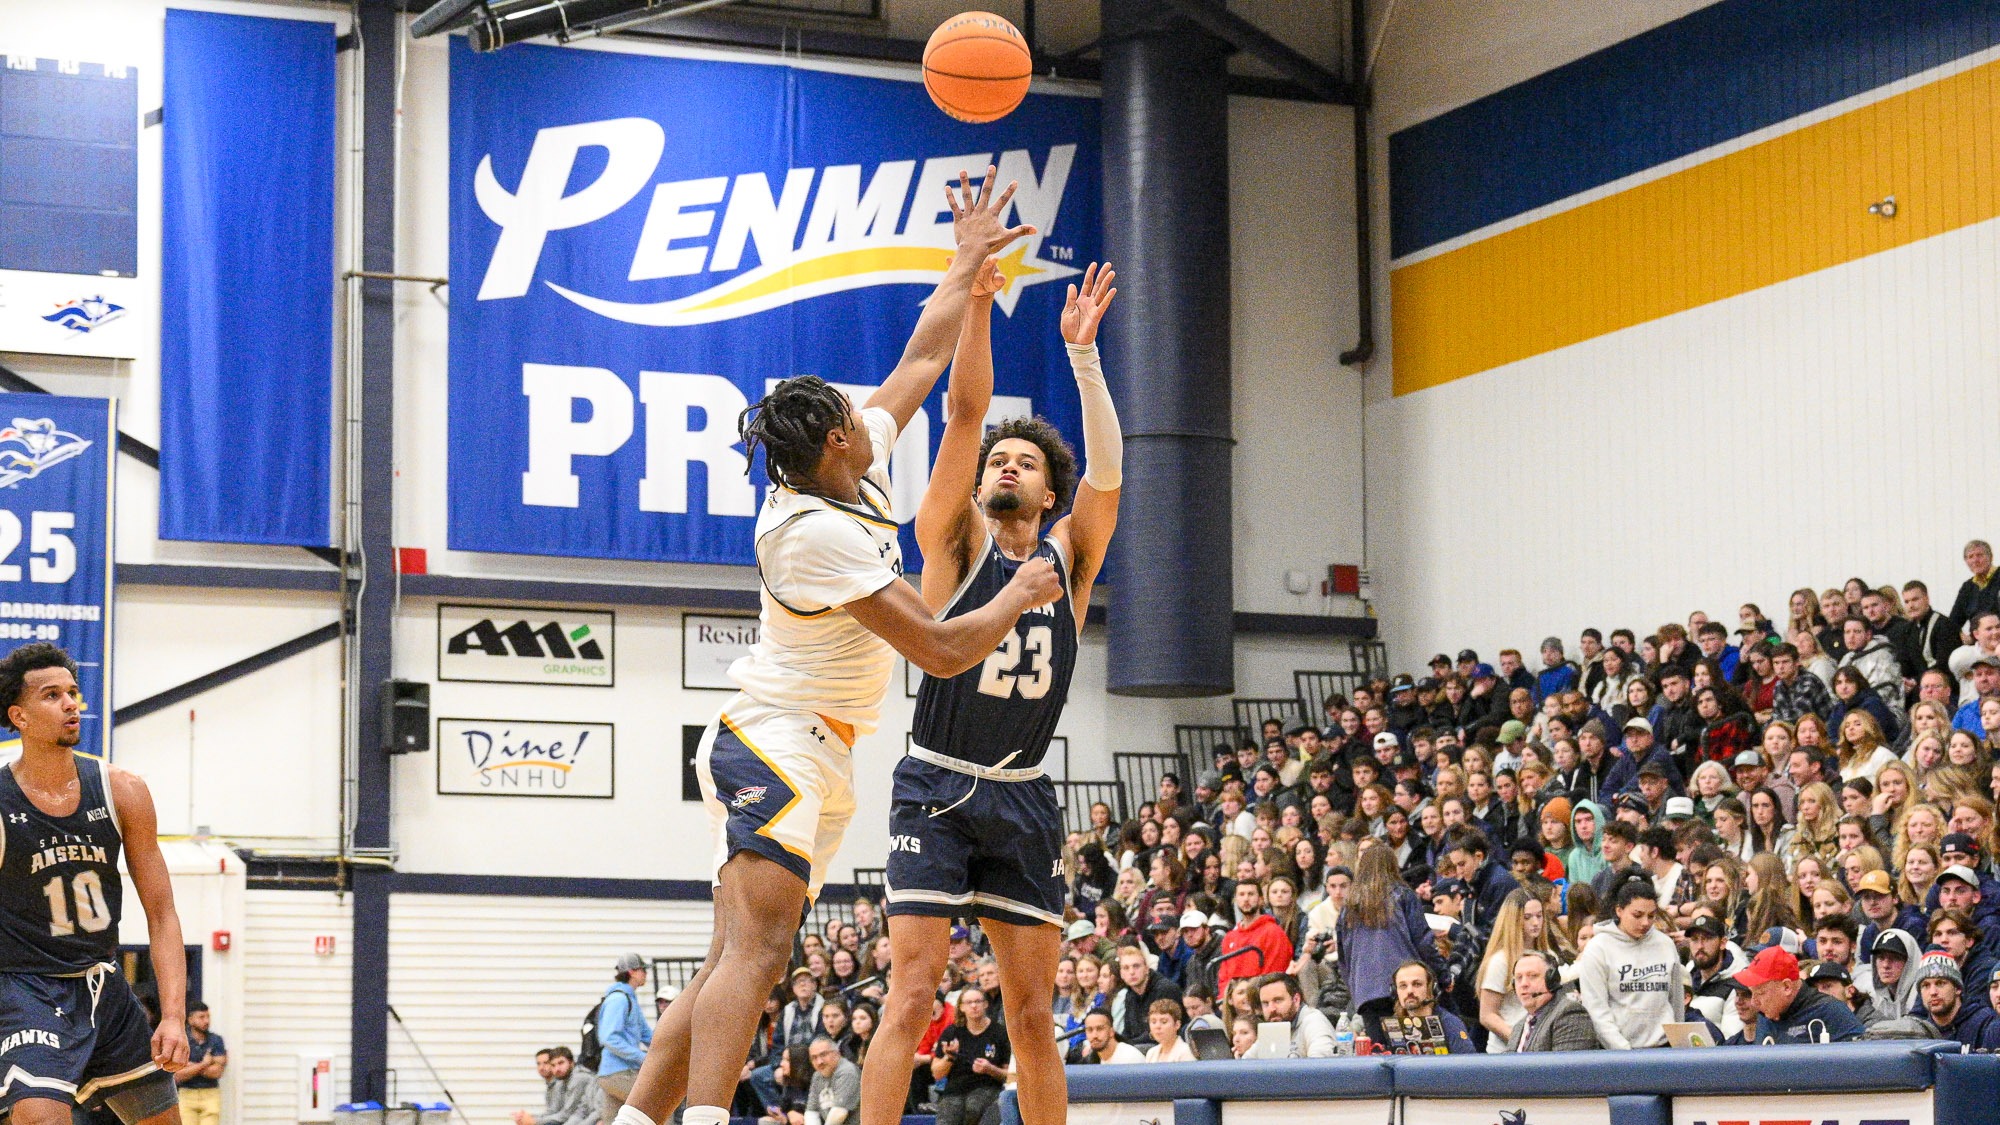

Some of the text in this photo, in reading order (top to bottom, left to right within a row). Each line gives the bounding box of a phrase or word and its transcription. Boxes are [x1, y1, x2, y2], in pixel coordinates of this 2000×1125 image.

[1050, 245, 1074, 260] TM
[0, 623, 60, 640] 986-90
[699, 624, 761, 645] Resid
[543, 664, 606, 676] GRAPHICS
[977, 625, 1053, 700] 23
[461, 730, 590, 768] Dine!
[480, 768, 568, 789] SNHU
[40, 834, 93, 848] SAINT
[31, 845, 108, 874] ANSELM
[42, 869, 112, 937] 10
[1618, 963, 1667, 982] PENMEN
[1619, 982, 1669, 993] CHEERLEADING
[0, 1028, 60, 1057] HAWKS
